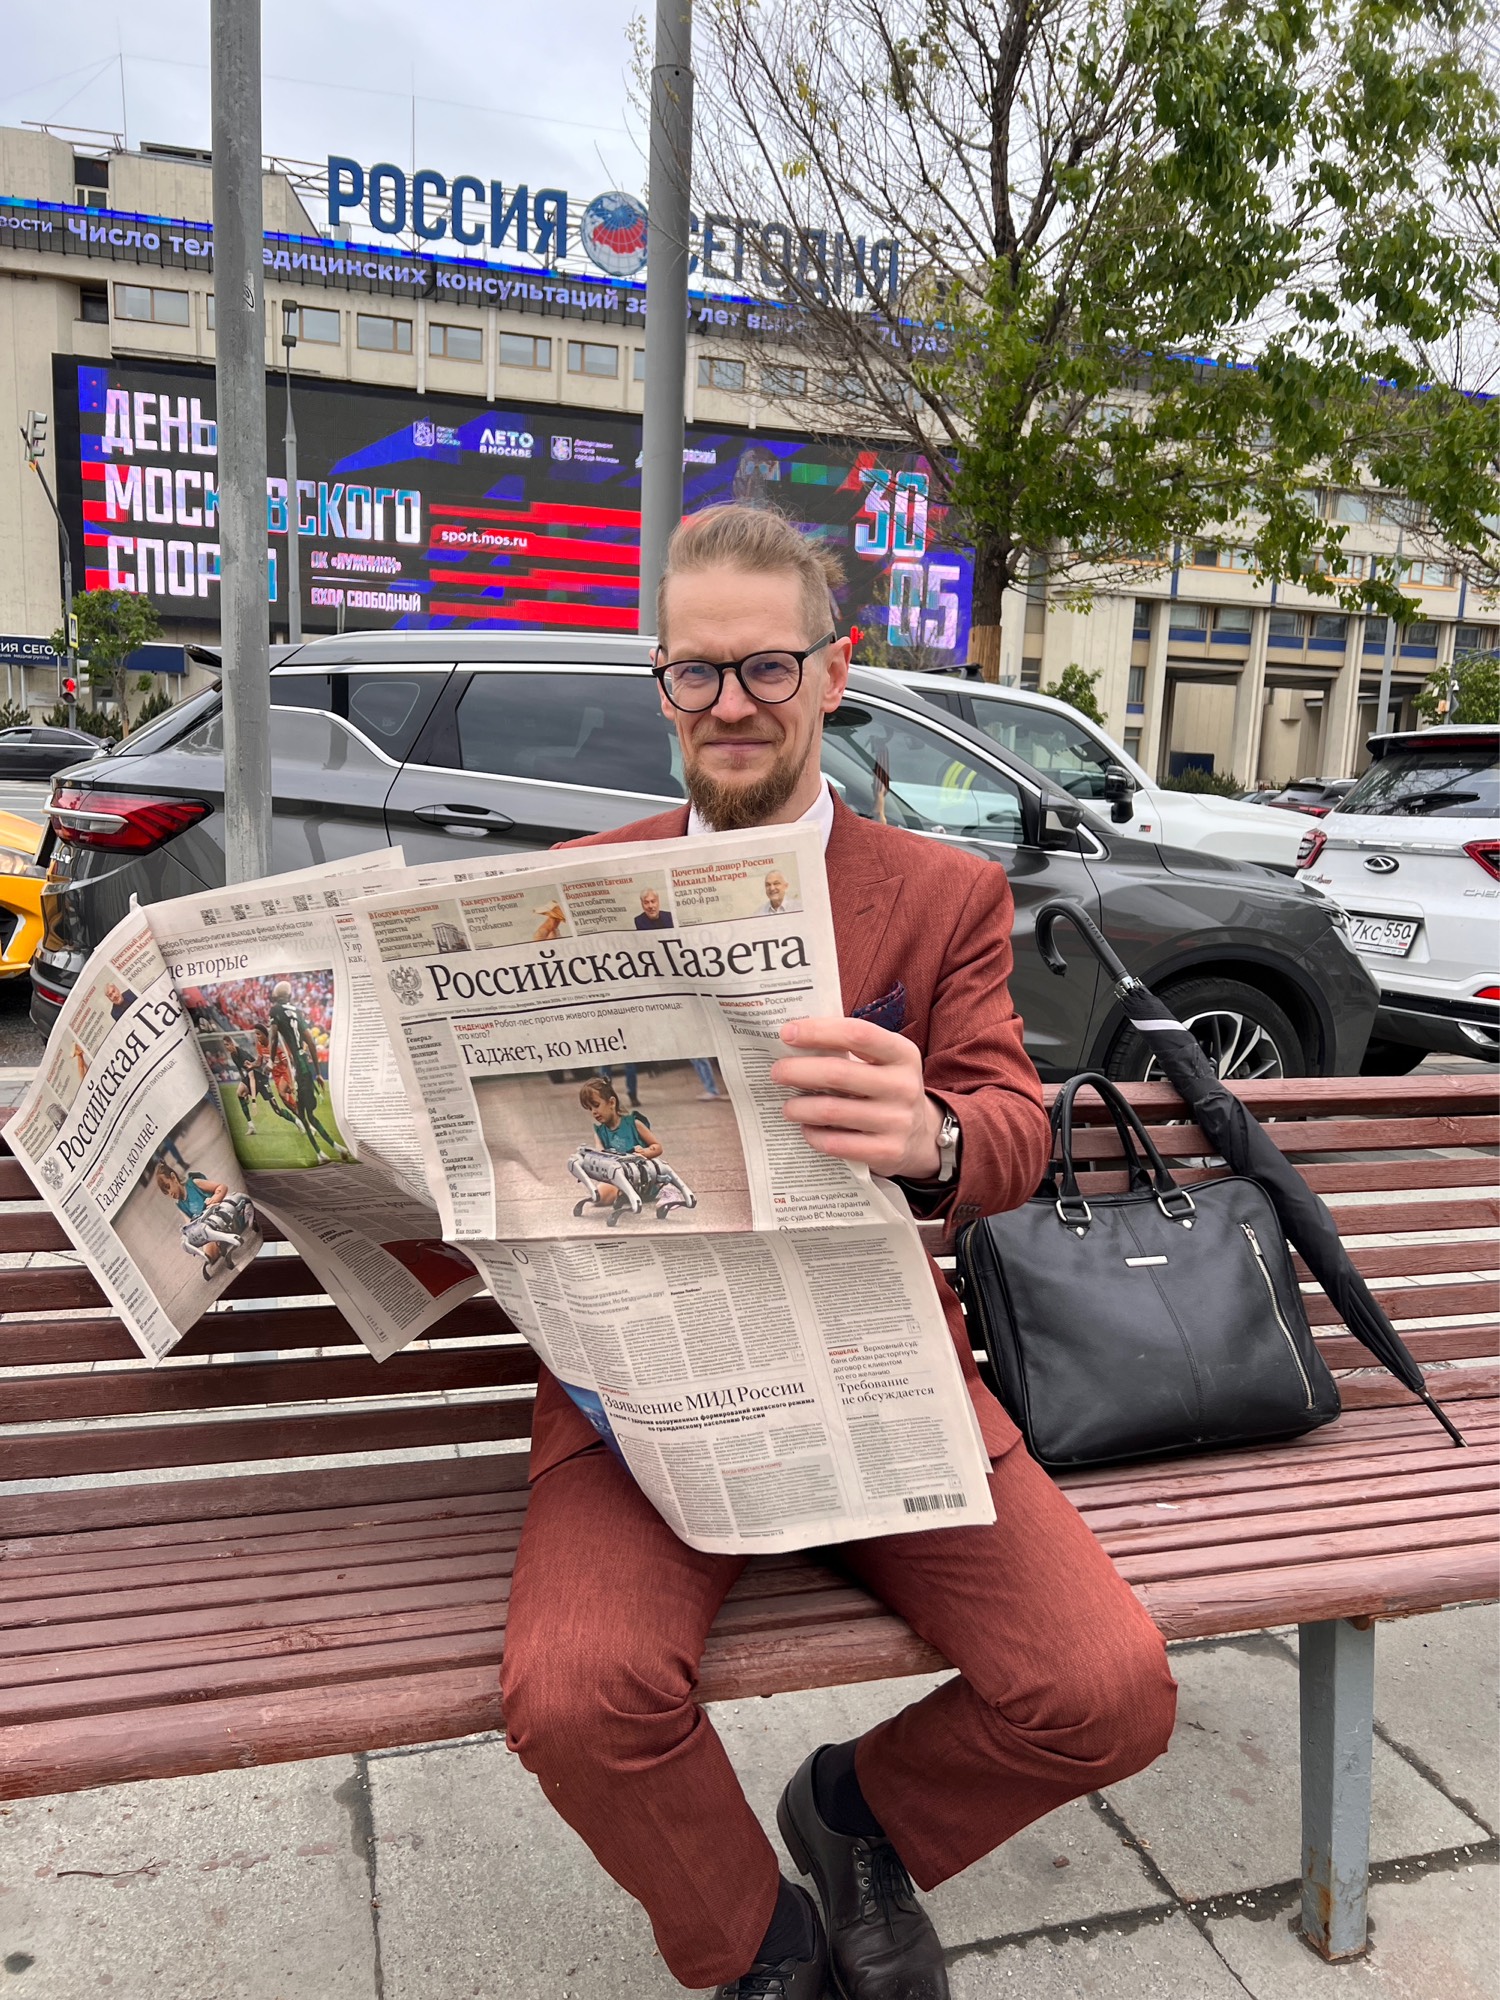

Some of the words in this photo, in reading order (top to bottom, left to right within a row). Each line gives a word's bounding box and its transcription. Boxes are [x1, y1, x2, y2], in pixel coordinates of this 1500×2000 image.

[328, 155, 567, 258] РОССИЯ
[68, 218, 160, 251] Число
[436, 271, 618, 311] консультаций
[101, 389, 218, 456] ДЕНЬ
[480, 428, 534, 448] ЛЕТО
[488, 446, 533, 458] МОСКВЕ
[104, 463, 421, 544] МОСКВСКОГО
[855, 469, 929, 558] 30
[441, 529, 528, 548] sport.mos.ru
[107, 535, 277, 602] СПОР
[347, 590, 421, 612] СВОБОДНЫЙ
[887, 562, 960, 650] 05
[23, 644, 55, 656] СЕГО
[671, 865, 714, 878] Почетный
[715, 862, 741, 872] донор
[742, 857, 774, 868] России
[672, 877, 707, 888] Михаил
[707, 871, 747, 883] Мытарев
[674, 889, 692, 897] сдал
[693, 886, 717, 897] кровь
[705, 895, 719, 904] раз
[158, 939, 179, 951] ребро
[179, 934, 226, 945] Премьер-лиги
[256, 925, 276, 935] финал
[276, 922, 296, 932] Кубка
[296, 920, 313, 928] стали
[219, 938, 258, 947] невезением
[258, 930, 304, 942] одновременно
[1384, 922, 1411, 940] 550
[187, 954, 249, 978] вторые
[427, 949, 661, 1001] Российская
[658, 933, 811, 979] Газета
[764, 995, 803, 1005] Россияне
[454, 1022, 494, 1032] ТЕНДЕНЦИЯ
[494, 1018, 533, 1028] Робот-пес
[535, 1014, 564, 1025] против
[566, 1010, 595, 1020] живого
[597, 1005, 644, 1018] домашнего
[646, 1002, 683, 1012] питомца:
[748, 1007, 787, 1016] скачивают
[471, 1029, 491, 1039] кого?
[731, 1024, 761, 1037] Копия
[761, 1031, 780, 1039] нев
[461, 1044, 543, 1066] Гаджет,
[545, 1041, 571, 1058] ко
[575, 1028, 627, 1055] мне!
[95, 1164, 133, 1213] Гаджет,
[127, 1146, 139, 1169] ко
[135, 1113, 159, 1150] мне!
[790, 1194, 819, 1203] Высшая
[820, 1191, 858, 1201] судейская
[775, 1205, 807, 1213] коллегия
[808, 1203, 836, 1211] лишила
[837, 1200, 870, 1209] гарантий
[777, 1214, 813, 1223] экс-судью
[814, 1212, 824, 1220] ВС
[826, 1210, 864, 1218] Момотова
[829, 1348, 859, 1356] КОШЕЛЕК
[863, 1341, 904, 1352] Верховный
[874, 1350, 918, 1360] расторгнуть
[833, 1365, 861, 1374] договор
[867, 1360, 902, 1368] клиентом
[858, 1369, 890, 1378] желанию
[837, 1377, 909, 1394] Требование
[602, 1393, 683, 1415] Заявление
[685, 1388, 737, 1410] МИД
[736, 1382, 805, 1403] России
[841, 1395, 856, 1405] не
[857, 1386, 935, 1403] обсуждается
[752, 1403, 786, 1412] киевского
[787, 1398, 815, 1408] режима
[741, 1412, 765, 1421] России
